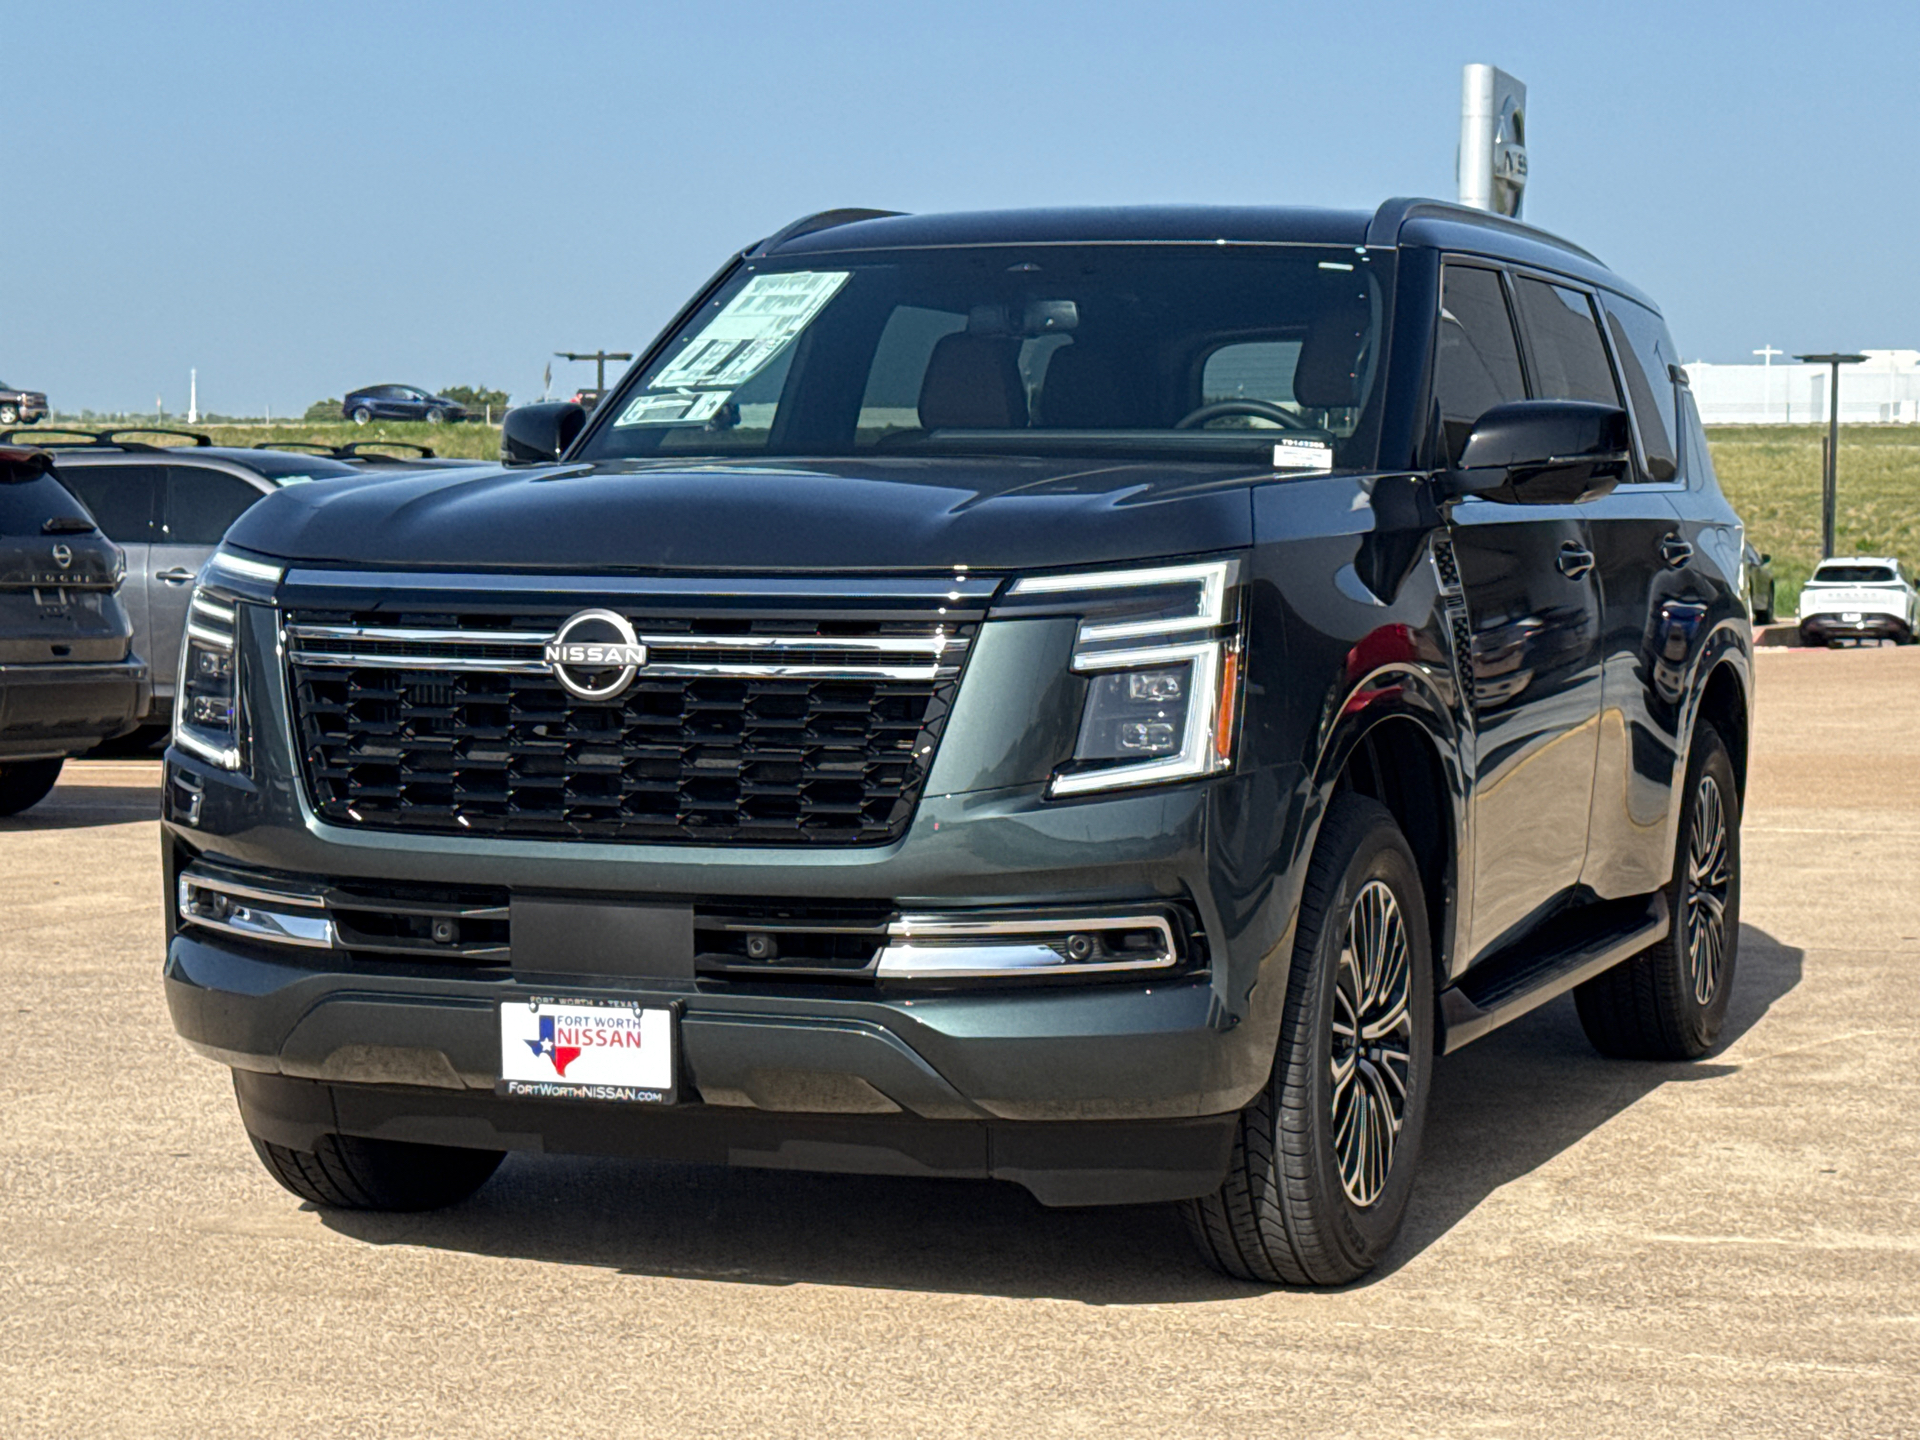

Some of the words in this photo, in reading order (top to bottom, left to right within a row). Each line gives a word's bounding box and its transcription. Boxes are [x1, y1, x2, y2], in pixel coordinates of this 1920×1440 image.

[545, 646, 643, 663] NISSAN
[529, 996, 554, 1004] FORT
[558, 998, 594, 1007] WORTH
[607, 1000, 639, 1008] TEXAS
[557, 1015, 591, 1027] FORT
[594, 1017, 641, 1029] WORTH
[557, 1028, 641, 1048] NISSAN
